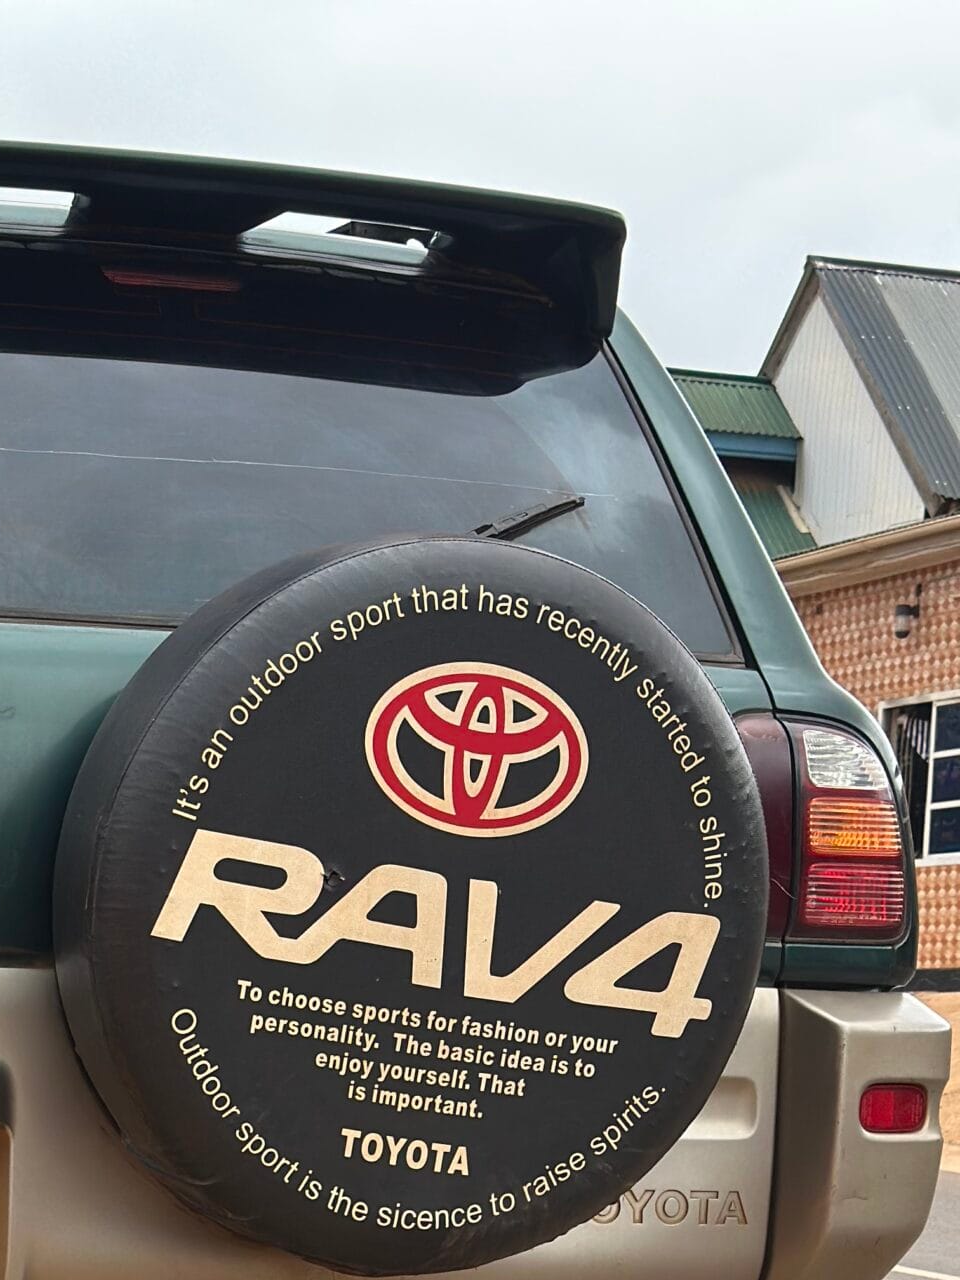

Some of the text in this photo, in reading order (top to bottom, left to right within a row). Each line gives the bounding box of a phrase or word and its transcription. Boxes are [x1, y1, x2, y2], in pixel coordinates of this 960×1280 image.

[172, 583, 728, 908] It's an outdoor sport that has recently started to shine.
[150, 828, 721, 1039] RAV4
[237, 979, 619, 1054] To choose sports for fashion or your
[249, 1014, 596, 1078] personality. The basic idea is to
[315, 1052, 526, 1097] enjoy yourself. That
[347, 1079, 483, 1119] is important.
[171, 1008, 667, 1230] Outdoor sport is the sicence to raise spirits.
[341, 1127, 469, 1176] TOYOTA
[592, 1188, 748, 1226] YOTA
